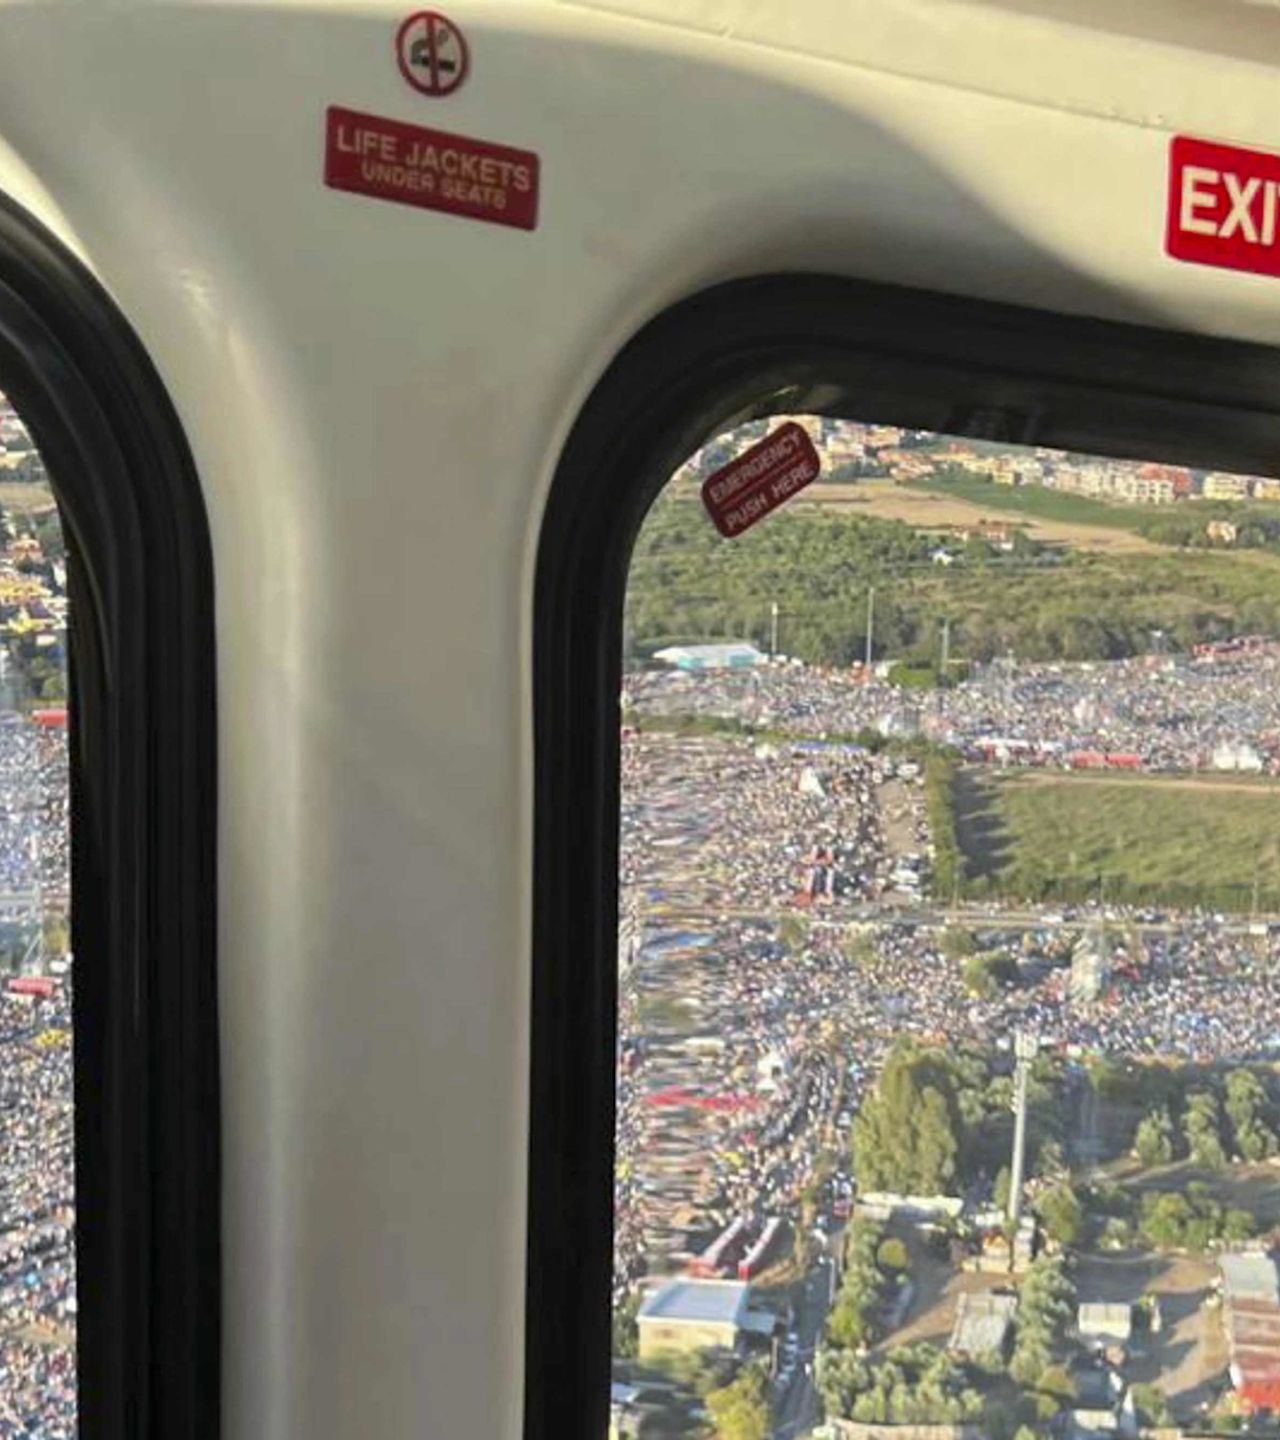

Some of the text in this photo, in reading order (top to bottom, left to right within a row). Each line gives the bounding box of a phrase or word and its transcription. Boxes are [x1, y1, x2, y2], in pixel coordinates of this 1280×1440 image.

[337, 126, 531, 191] LIFE JACKETS
[361, 162, 507, 209] UNDER SEATS
[709, 430, 800, 503] EMERGENCY
[725, 464, 815, 530] PUSH HERE
